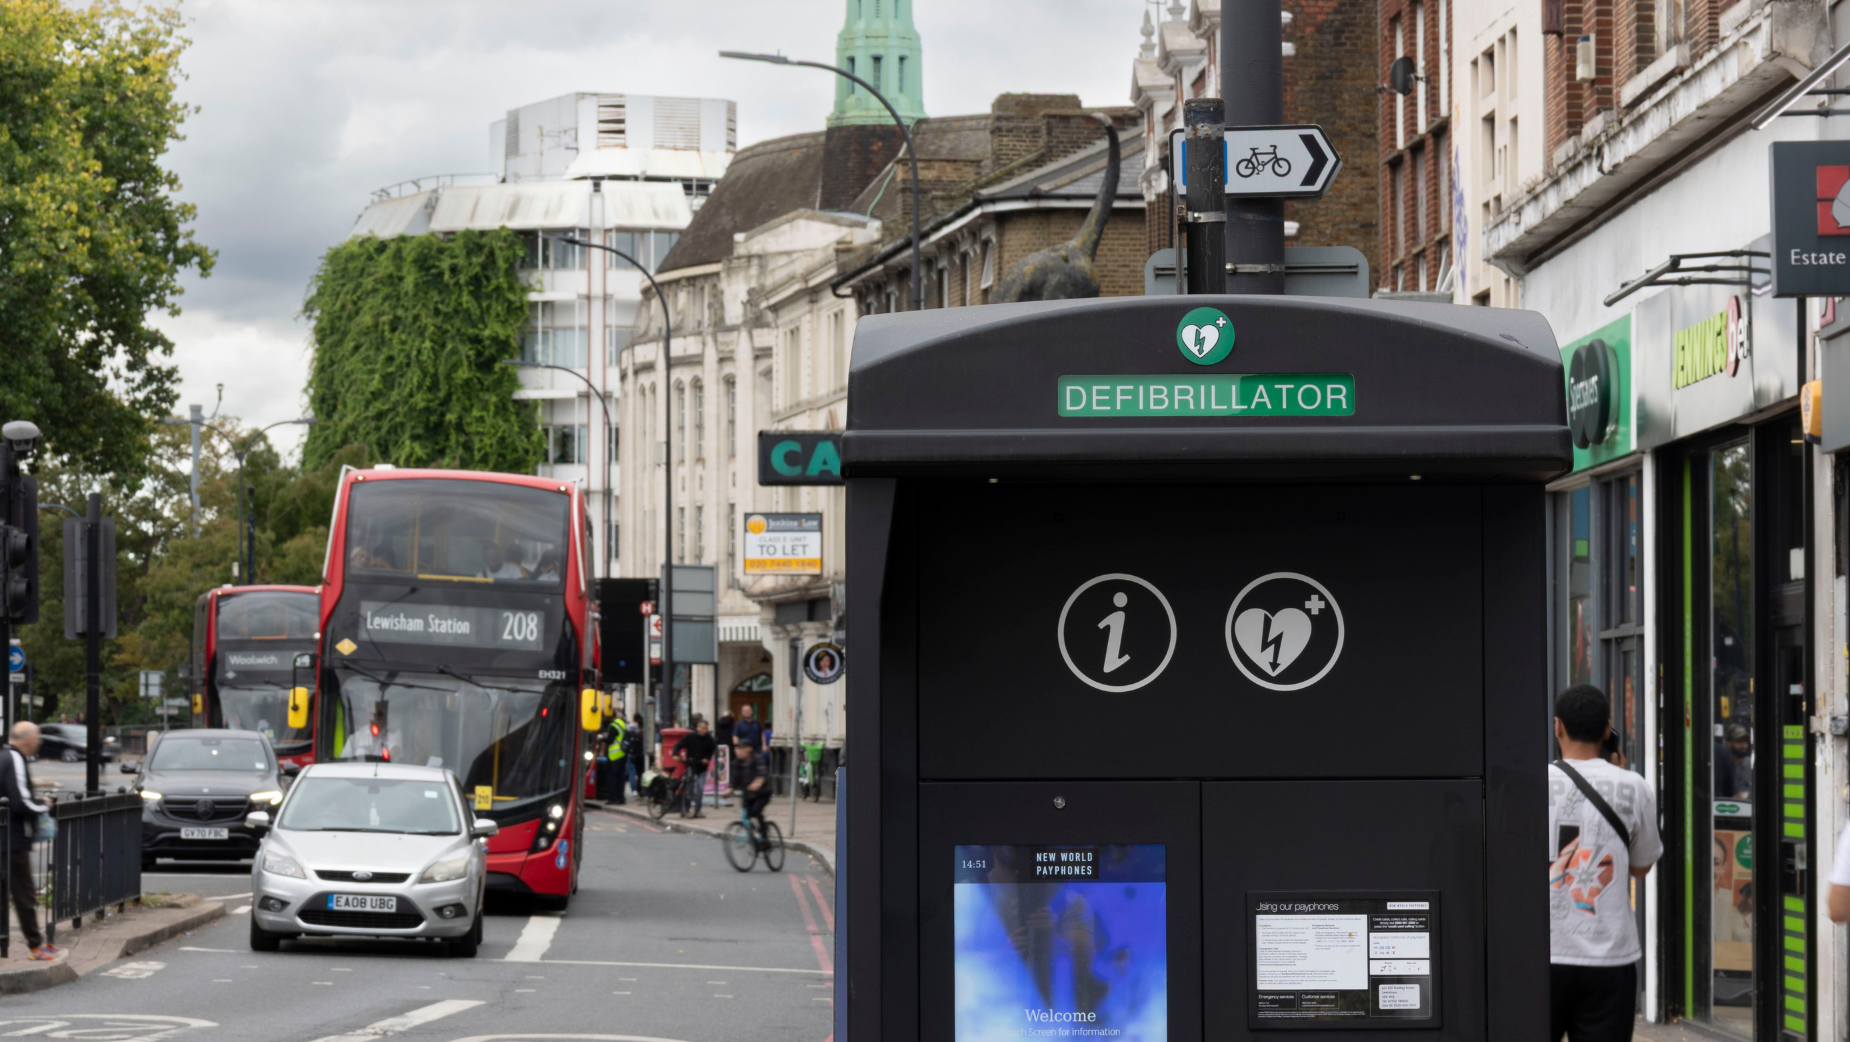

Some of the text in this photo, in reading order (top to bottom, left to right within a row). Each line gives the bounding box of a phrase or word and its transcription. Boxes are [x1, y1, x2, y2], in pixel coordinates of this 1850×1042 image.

[1790, 248, 1846, 266] Estate
[1064, 383, 1348, 412] DEFIBRILLATOR
[757, 544, 809, 556] TO LET
[366, 610, 538, 641] Lewisham Station 208
[228, 654, 278, 666] Woolwich
[538, 669, 566, 680] EH321
[1036, 852, 1093, 862] NEW WORLD
[961, 859, 987, 869] 14:51
[1036, 865, 1093, 876] PAYPHONES
[334, 896, 395, 912] EA08 UBG
[1279, 903, 1293, 911] our
[1294, 902, 1339, 913] payphones
[1024, 1008, 1097, 1023] Welcome
[1028, 1027, 1057, 1037] Screen
[1057, 1027, 1070, 1037] for
[1071, 1027, 1121, 1037] information
